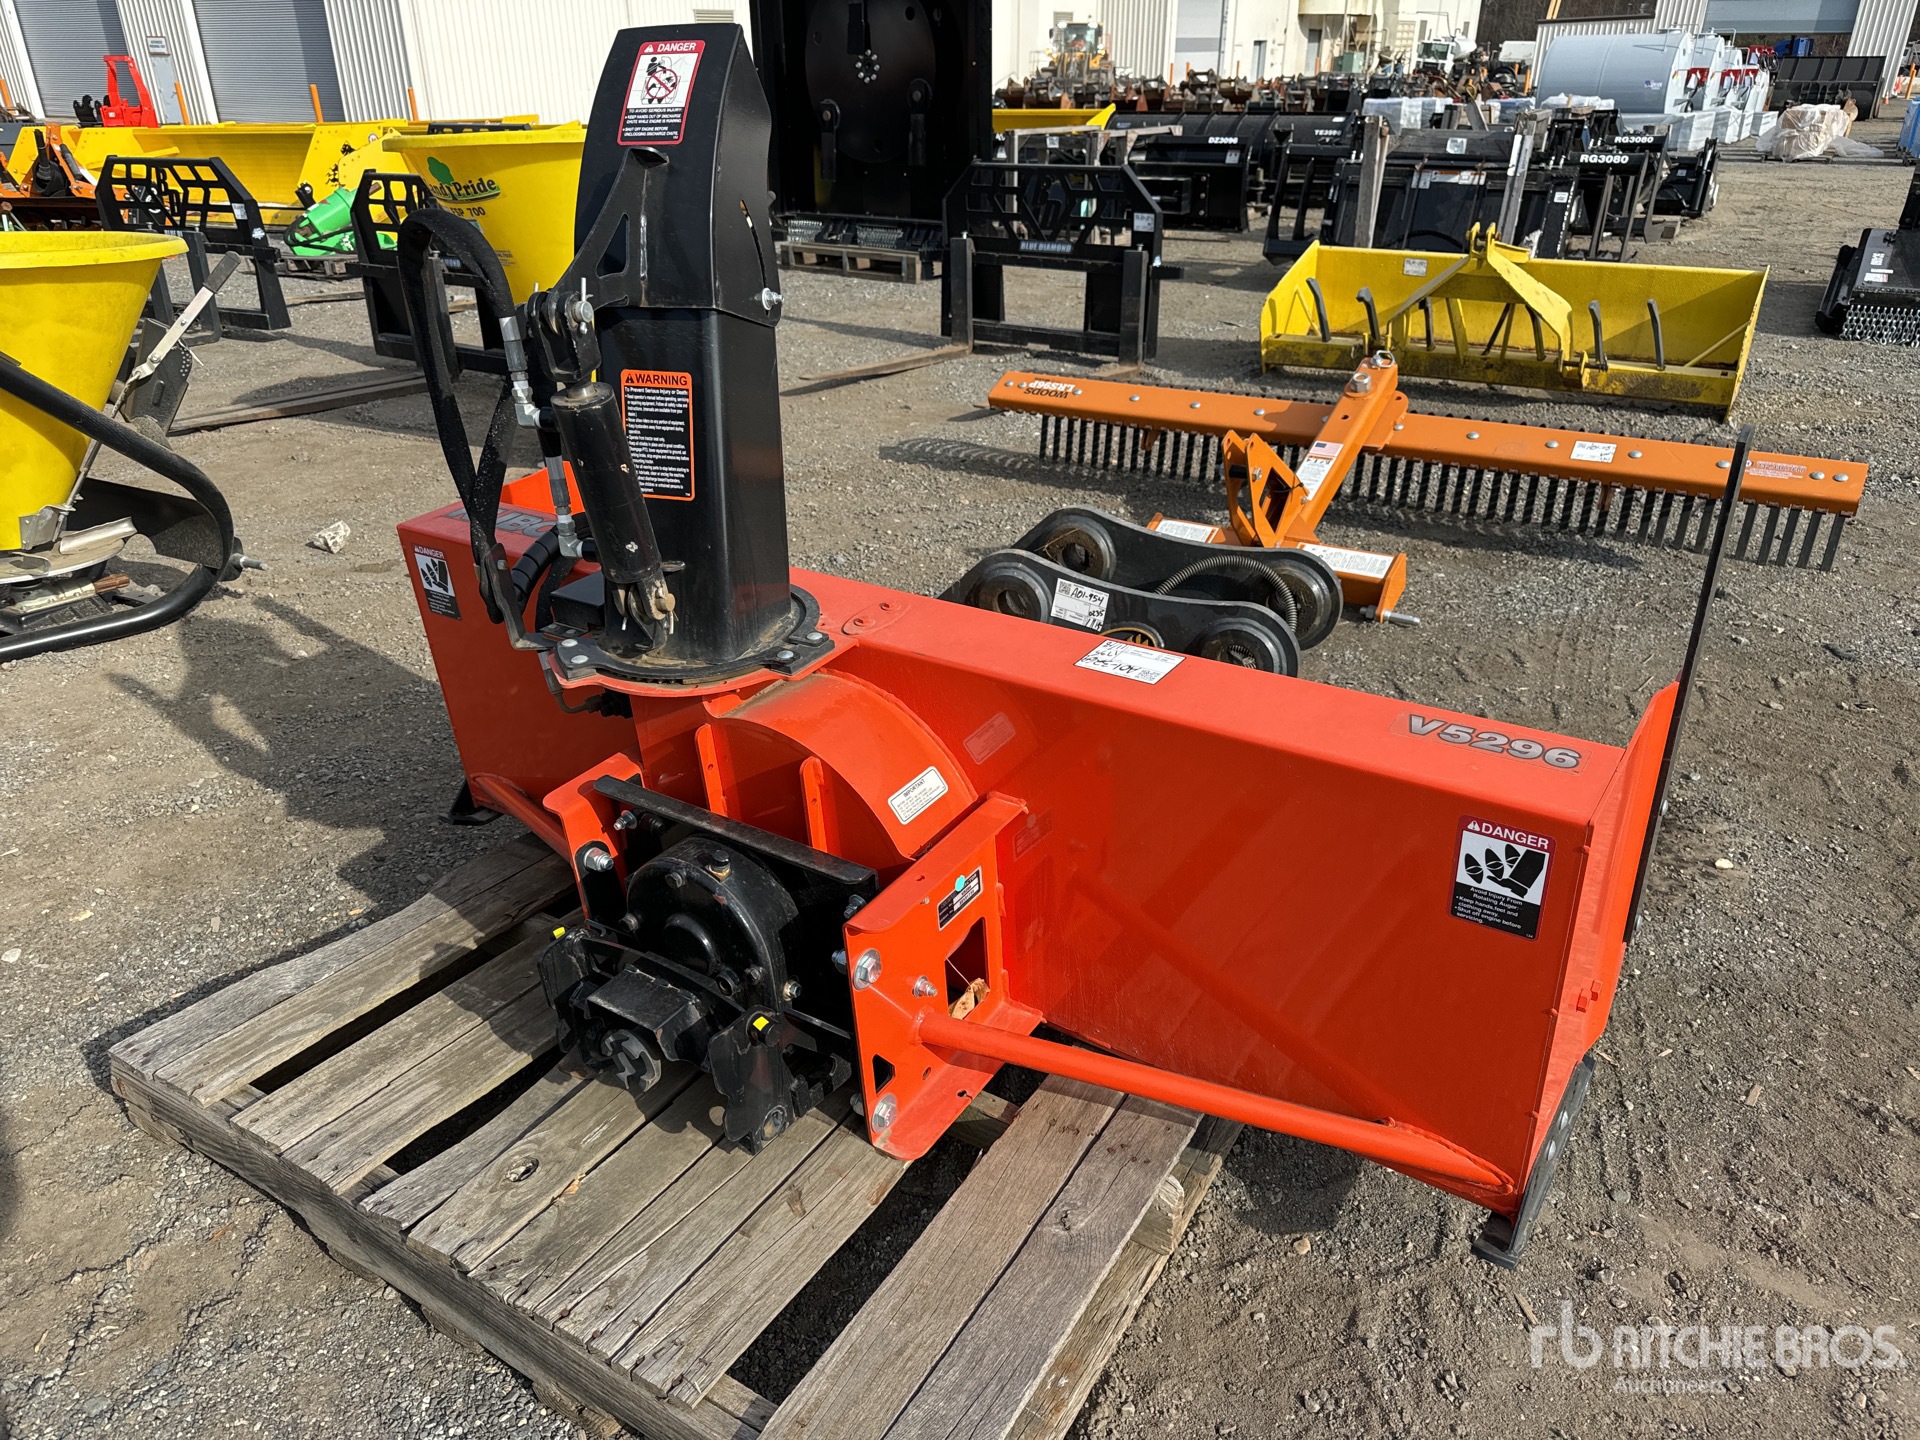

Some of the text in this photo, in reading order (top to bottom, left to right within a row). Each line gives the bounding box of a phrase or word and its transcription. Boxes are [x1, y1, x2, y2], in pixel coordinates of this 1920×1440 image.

[657, 42, 696, 52] DANGER
[1580, 154, 1629, 164] RG3080
[452, 178, 497, 196] Pride
[467, 207, 486, 216] 700
[1020, 242, 1072, 252] BLUE DIAMOND
[635, 374, 687, 385] WARNING
[1028, 380, 1075, 392] LRS96P
[1024, 388, 1068, 398] WOODS
[418, 546, 444, 559] DANGER
[1409, 714, 1582, 769] V5296
[903, 779, 925, 797] IMPORTANT
[1482, 822, 1549, 849] DANGER
[1459, 896, 1474, 904] Keep
[1470, 887, 1522, 906] Avoid Injury From
[1473, 893, 1498, 905] Rotating
[1458, 902, 1499, 918] clothing away.
[1457, 906, 1471, 914] Shut
[1481, 913, 1501, 923] engine
[1502, 919, 1522, 929] before
